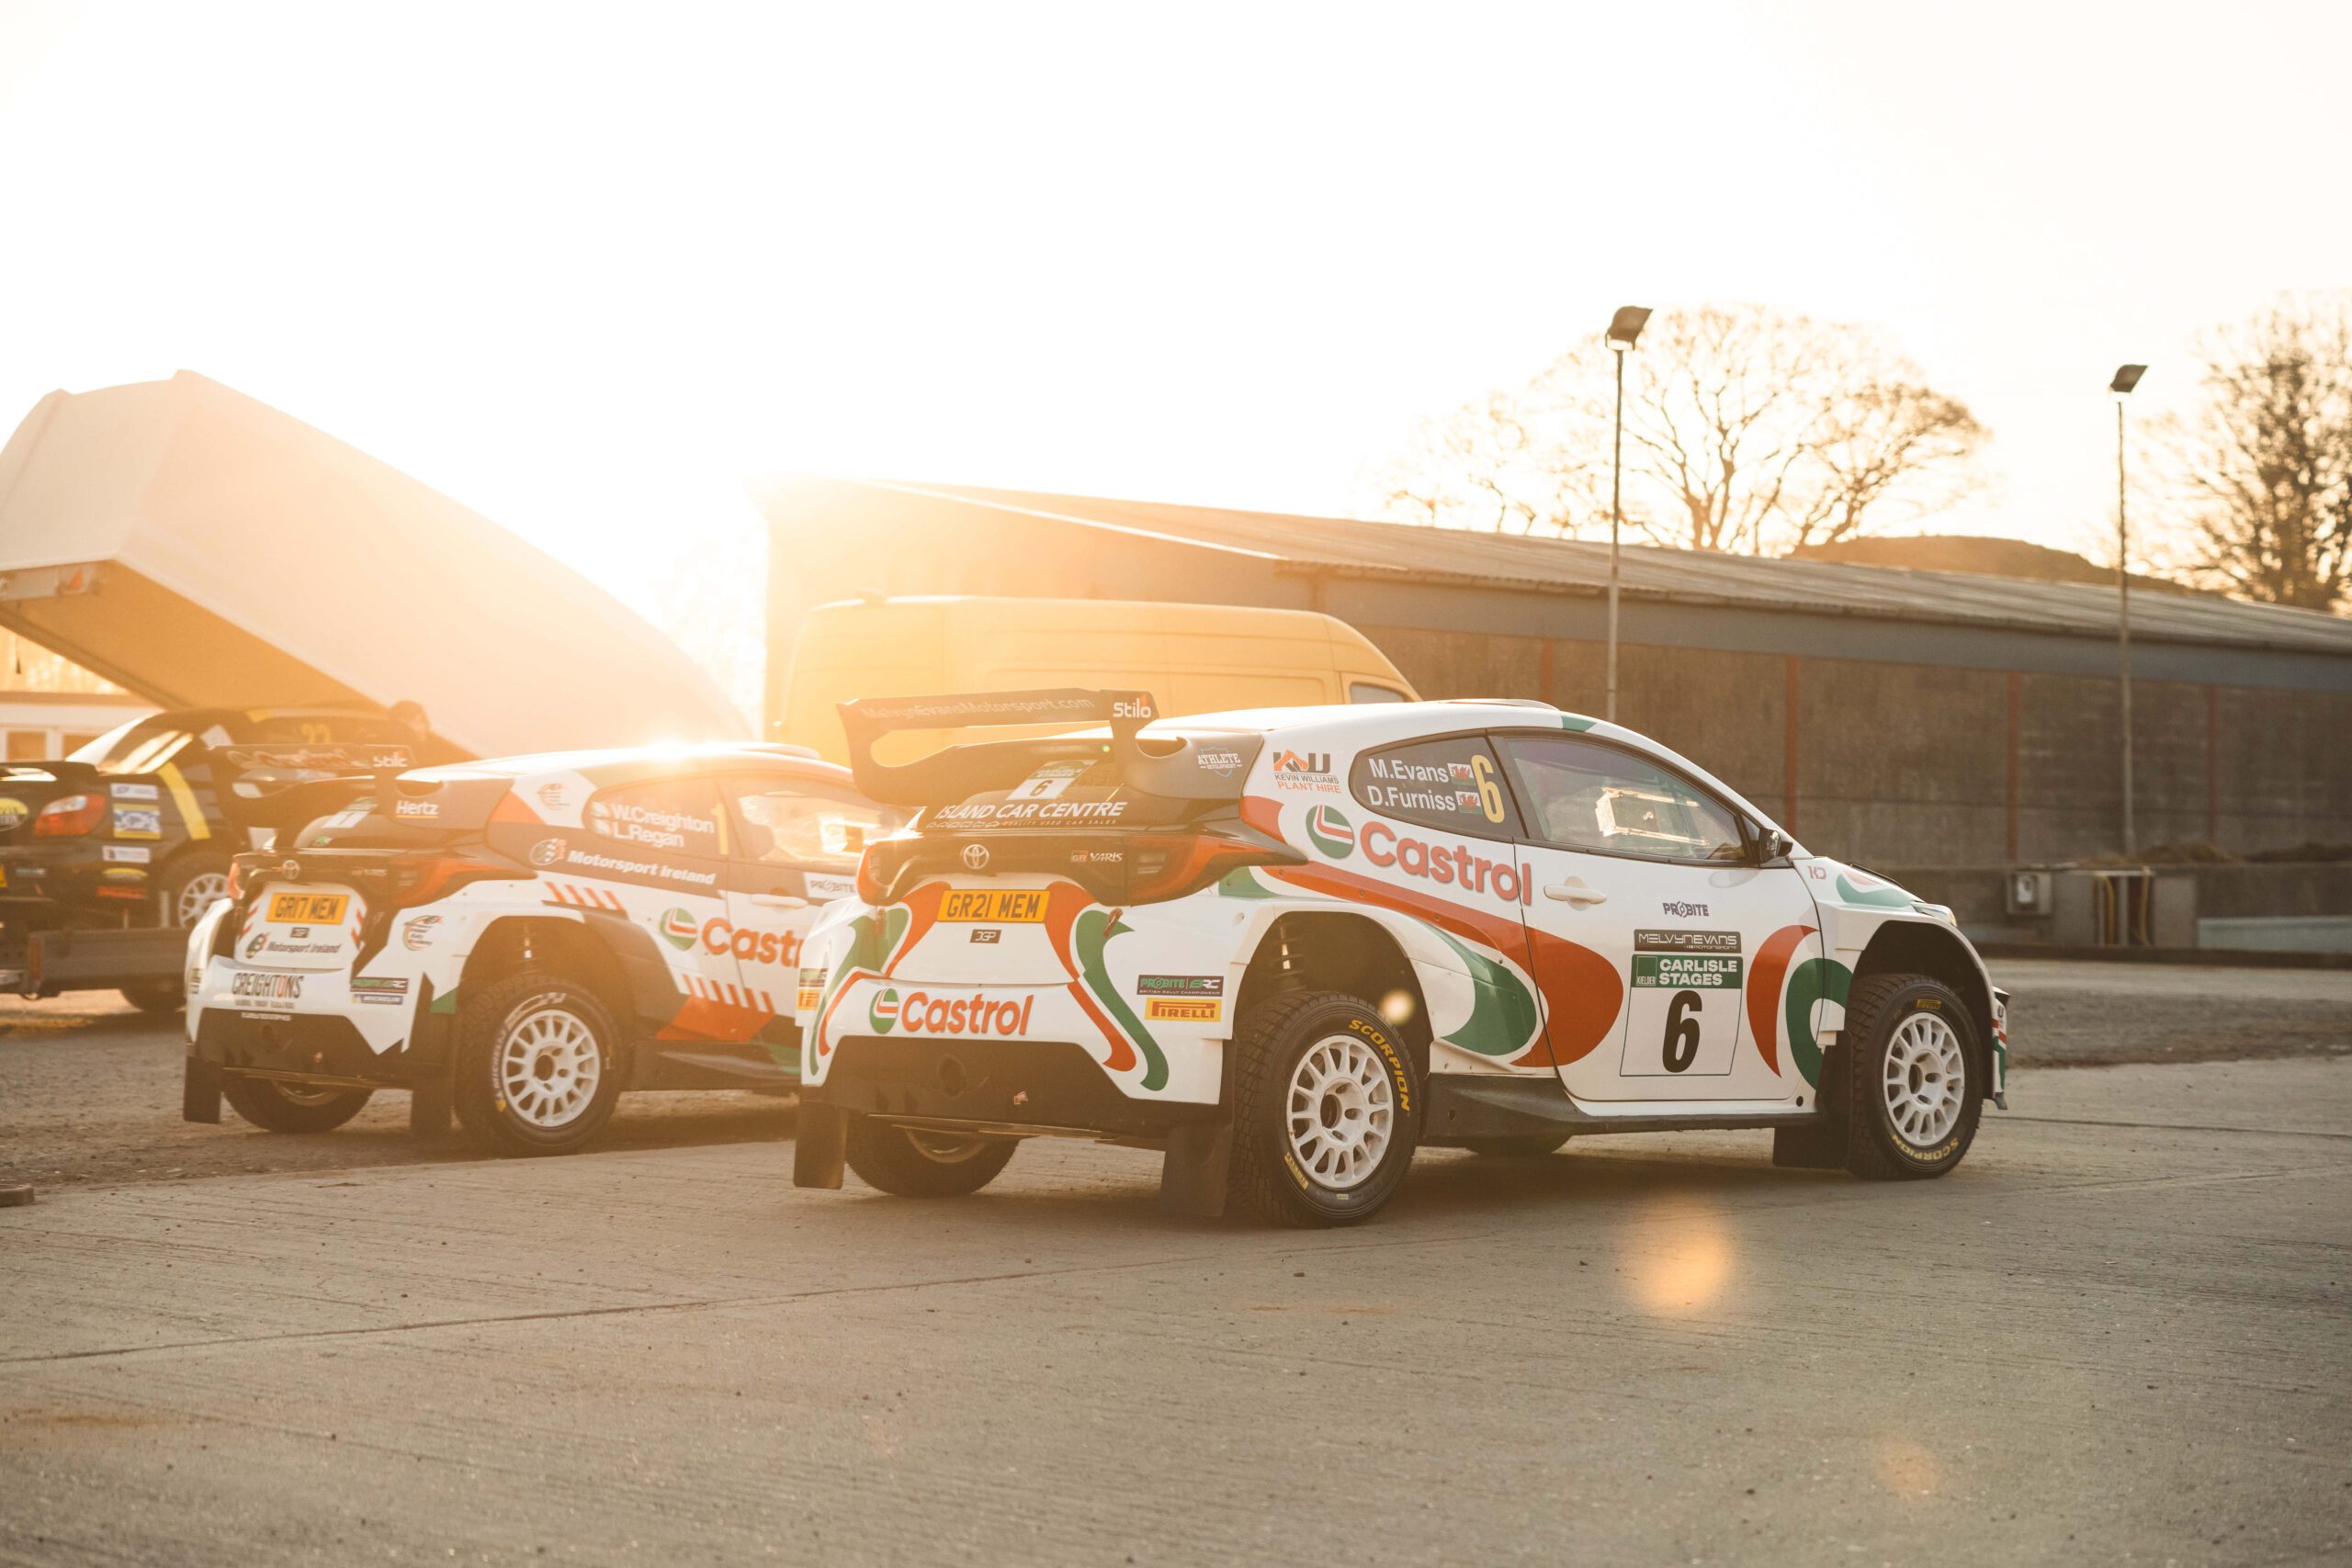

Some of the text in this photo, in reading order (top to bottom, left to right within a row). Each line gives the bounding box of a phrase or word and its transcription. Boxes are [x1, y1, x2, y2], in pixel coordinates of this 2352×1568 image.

[1113, 698, 1151, 718] Stilo
[1197, 753, 1240, 765] ATHLETE
[1368, 758, 1449, 783] M.Evans
[1030, 780, 1053, 796] 6
[1277, 782, 1341, 794] PLANT HIRE
[1300, 775, 1340, 784] WILLIAMS
[1472, 754, 1505, 823] 6
[396, 801, 439, 816] Hertz
[934, 801, 1128, 819] ISLAND CAR CENTRE
[1367, 785, 1456, 812] D.Furniss
[613, 822, 684, 848] L.Regan
[711, 803, 729, 855] 1
[568, 850, 658, 875] Motorsport
[660, 864, 717, 886] Ireland
[1360, 821, 1532, 907] Castrol
[276, 897, 340, 919] GR17 MEM
[947, 893, 1042, 919] GR21 MEM
[702, 917, 804, 968] Castr
[1659, 958, 1737, 973] CARLISLE
[232, 973, 304, 999] CREIGHTONS
[1636, 973, 1723, 986] KIELDER STAGES
[901, 991, 1034, 1035] Castrol
[1151, 1001, 1216, 1018] PIRELLI
[1662, 989, 1702, 1074] 6
[1349, 1019, 1410, 1111] SCORPION
[1891, 1134, 1959, 1160] SCORPION
